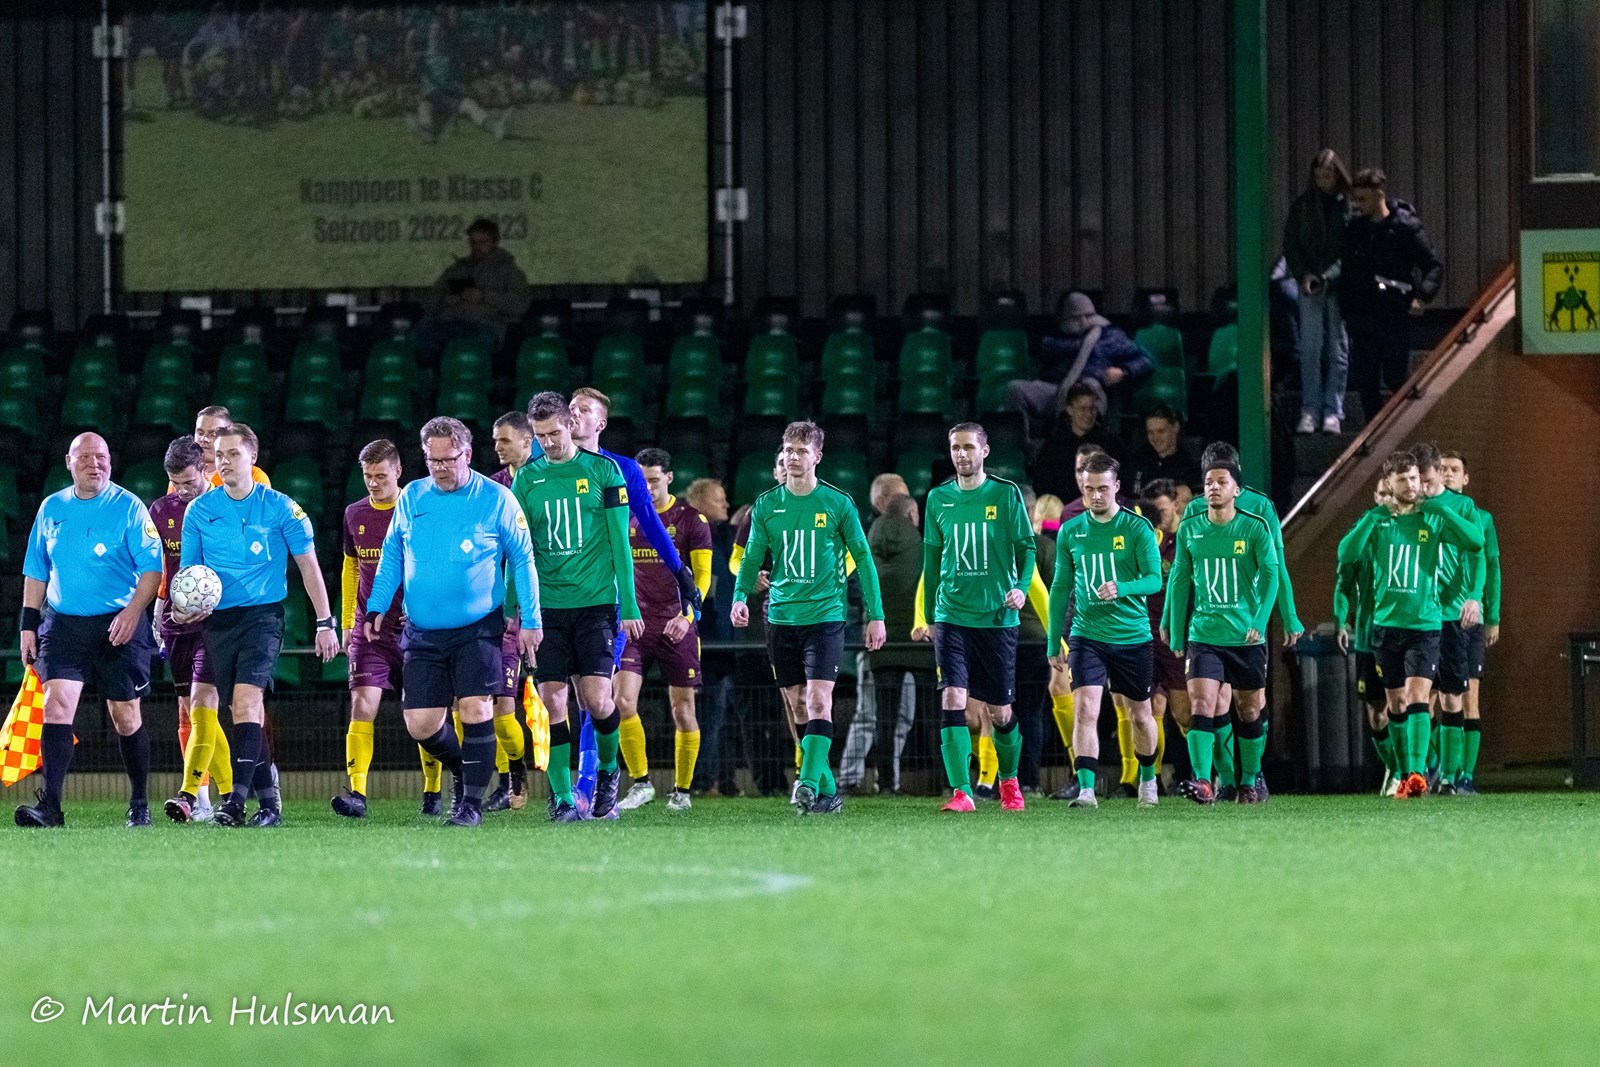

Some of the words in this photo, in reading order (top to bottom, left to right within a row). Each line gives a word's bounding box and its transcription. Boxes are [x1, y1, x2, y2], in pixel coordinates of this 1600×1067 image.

[300, 175, 411, 204] Kampioen
[448, 174, 522, 200] Klasse
[529, 171, 543, 199] C
[313, 216, 400, 243] Seizoen
[506, 667, 515, 678] 24
